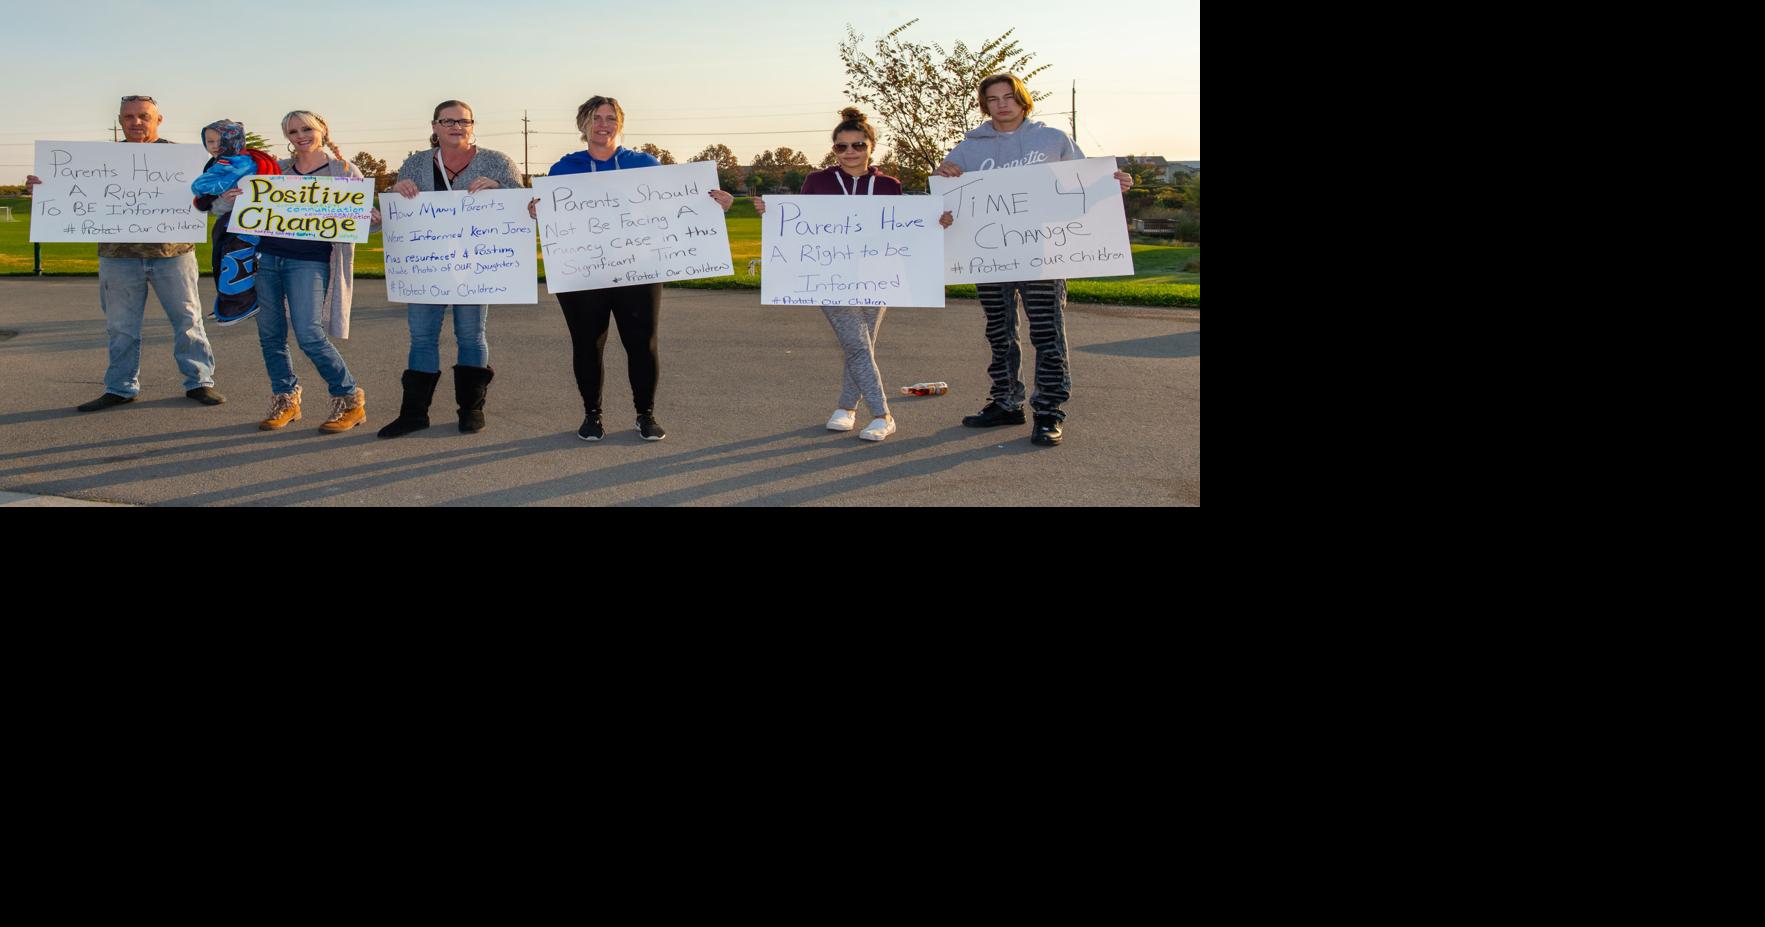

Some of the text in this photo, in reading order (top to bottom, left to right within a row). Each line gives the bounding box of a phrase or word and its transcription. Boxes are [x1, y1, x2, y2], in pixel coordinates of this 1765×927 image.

[49, 149, 187, 183] Parents Have
[69, 183, 164, 207] A Right
[249, 178, 366, 205] Positive
[551, 181, 699, 212] Parents Should
[1054, 172, 1087, 214] 4
[37, 199, 192, 217] To BE Informed
[388, 196, 505, 220] How Many Parents
[881, 205, 926, 231] Have
[128, 223, 152, 234] Our
[237, 206, 356, 239] Change
[409, 227, 464, 242] Informed
[501, 221, 531, 235] Jones
[545, 204, 699, 240] Not Be Facing A
[662, 233, 679, 243] in
[684, 226, 718, 237] this
[405, 250, 456, 263] resurfaced
[474, 243, 515, 258] Posting
[561, 246, 698, 278] Significant Time
[770, 242, 912, 267] A Right to be
[440, 263, 452, 272] of
[665, 267, 682, 278] Our
[429, 284, 451, 297] Our
[793, 274, 902, 294] Informed
